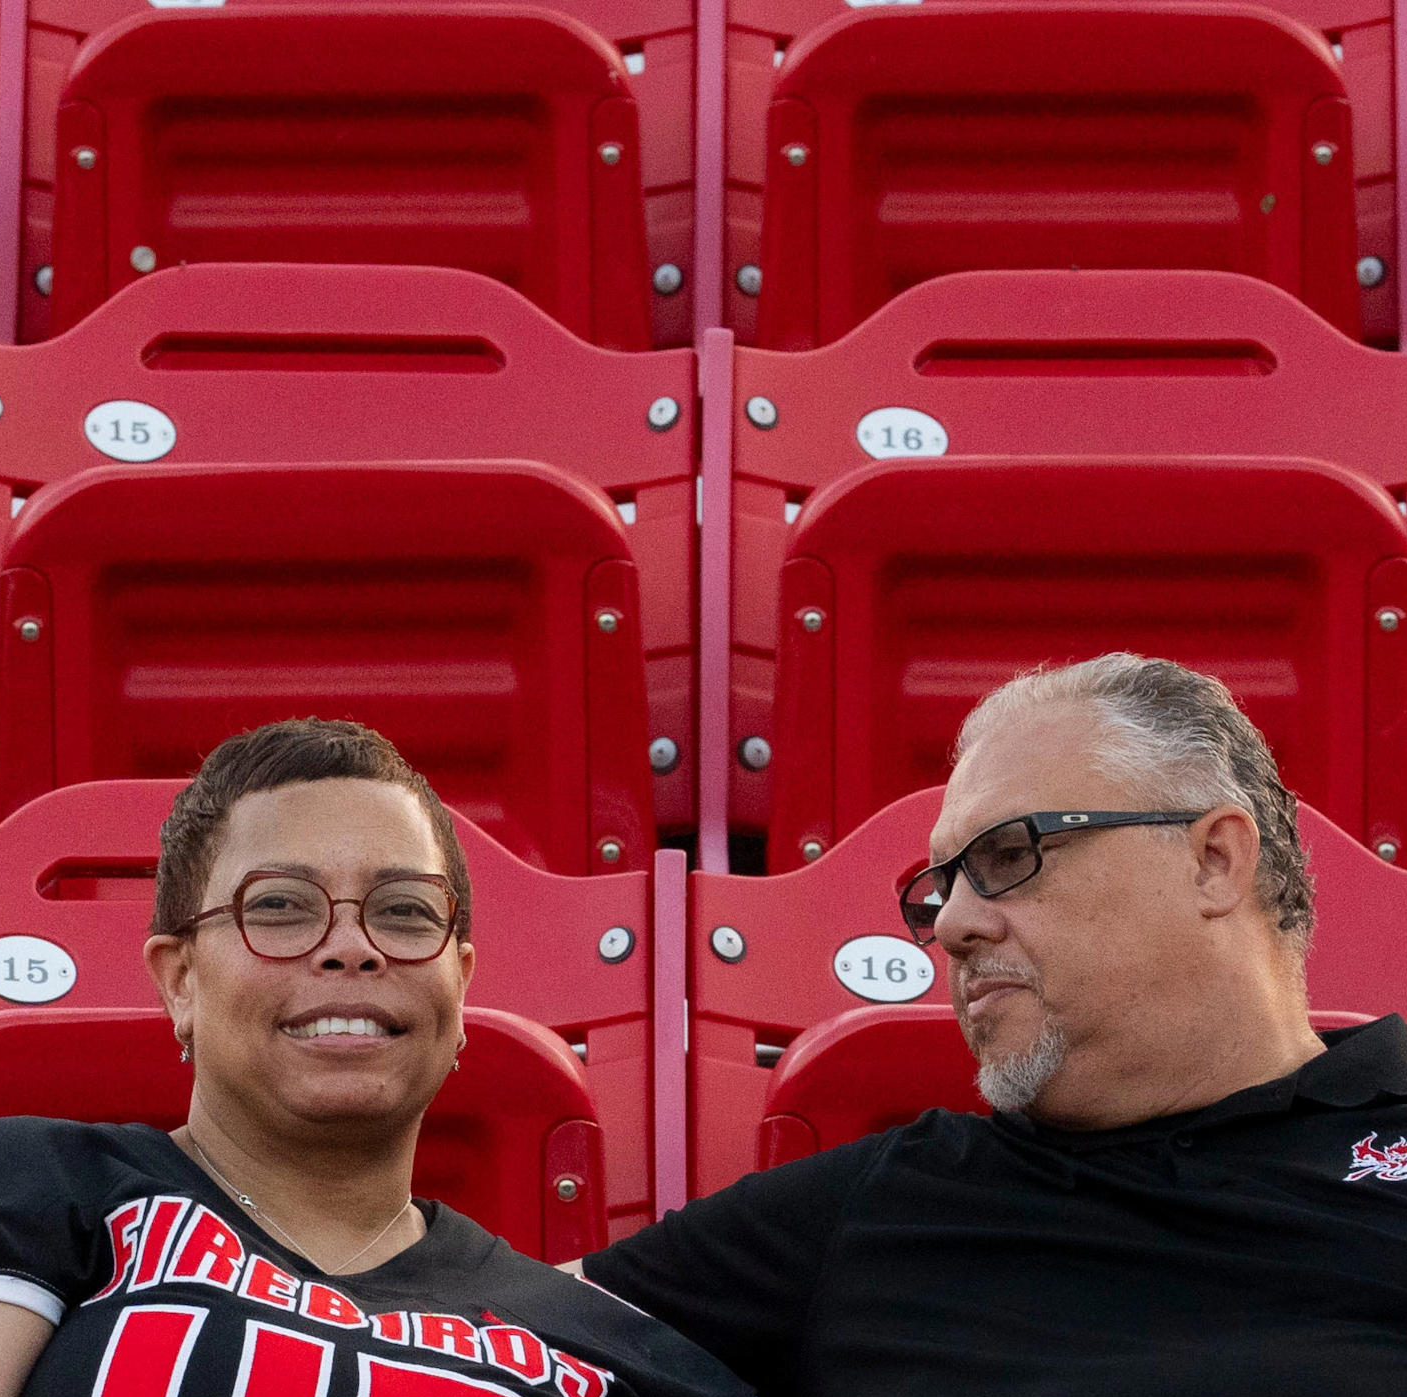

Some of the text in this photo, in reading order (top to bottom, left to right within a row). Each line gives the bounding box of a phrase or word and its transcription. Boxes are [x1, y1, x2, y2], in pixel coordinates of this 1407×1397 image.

[110, 419, 152, 445] 15
[882, 426, 925, 451] 16
[3, 956, 50, 985] 15
[861, 956, 909, 984] 16
